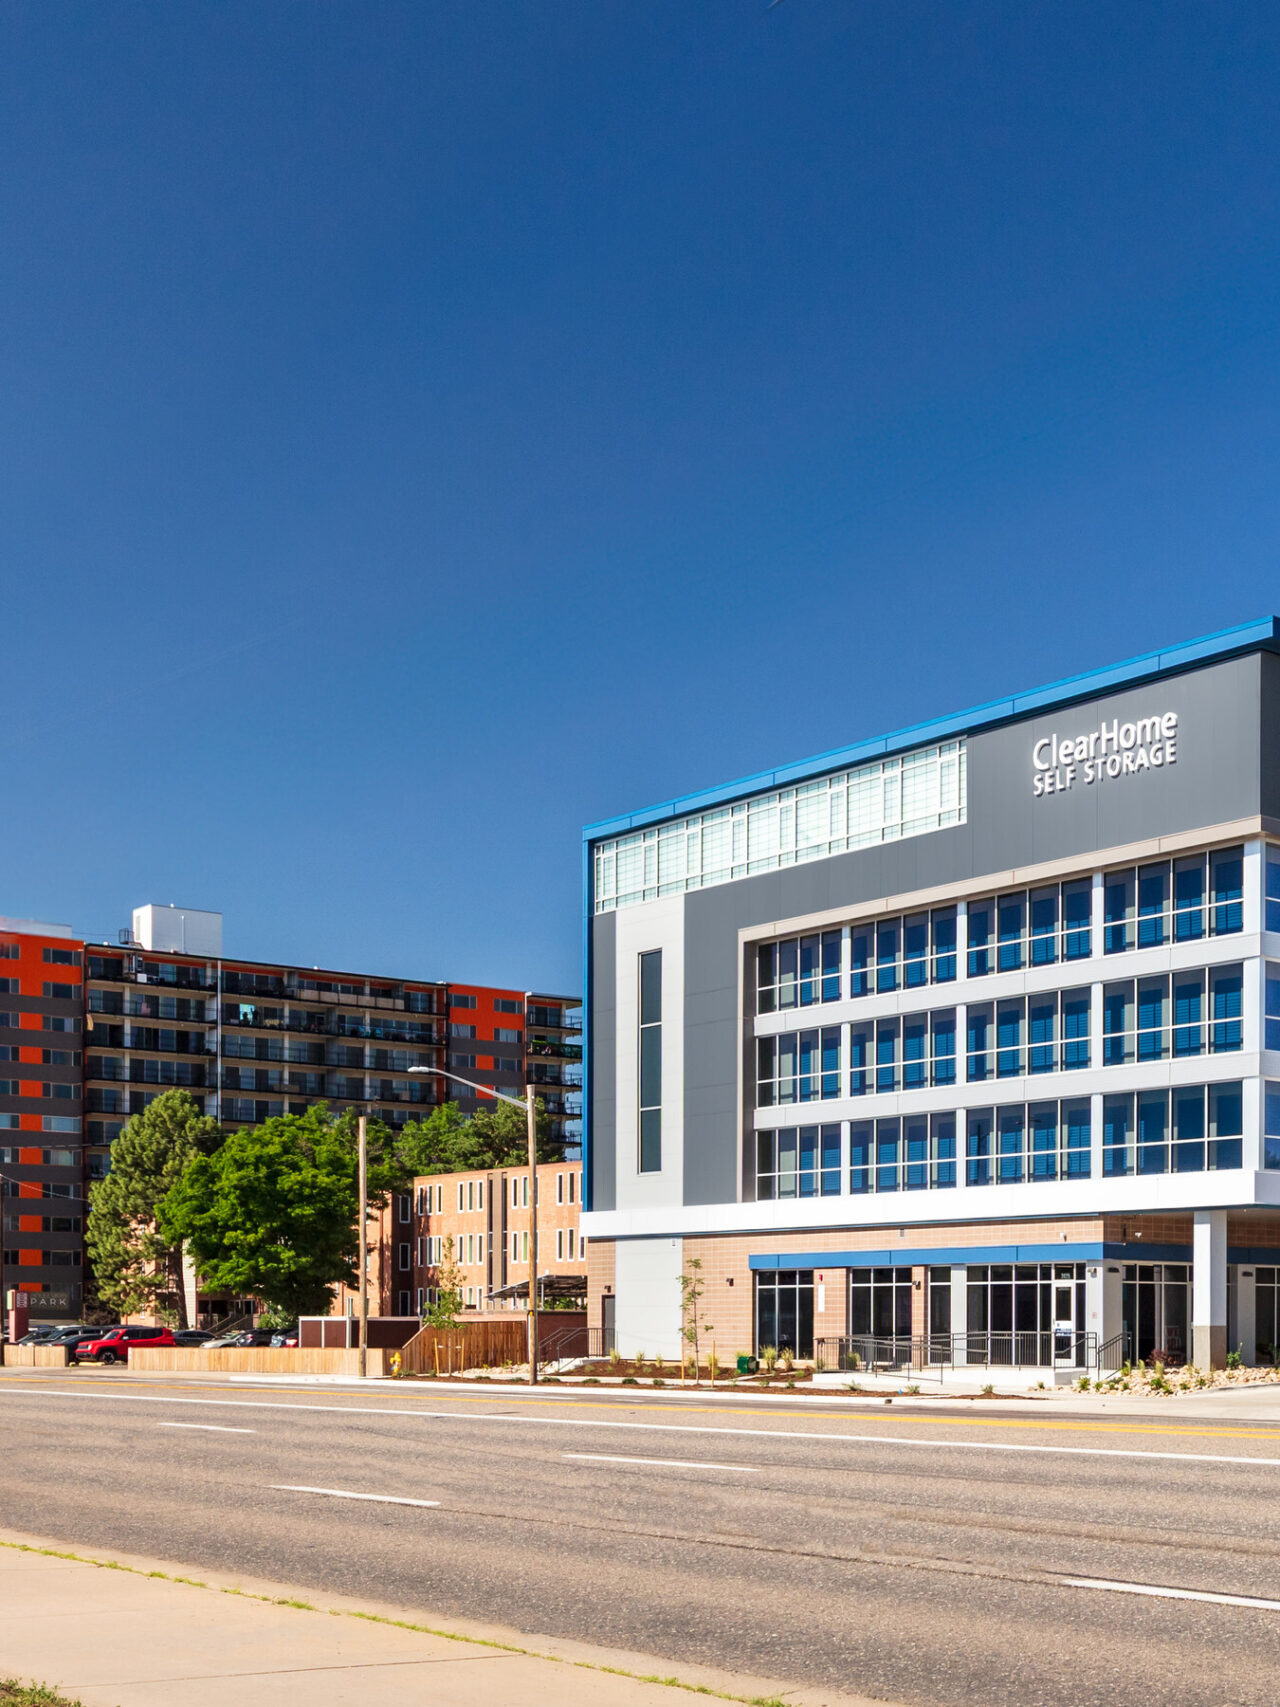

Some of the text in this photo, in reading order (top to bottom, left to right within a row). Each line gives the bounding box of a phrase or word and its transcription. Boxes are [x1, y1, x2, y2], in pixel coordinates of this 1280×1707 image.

[1033, 712, 1179, 771] ClearHome
[1033, 740, 1177, 796] SELF STORAGE
[30, 1298, 66, 1306] PARK
